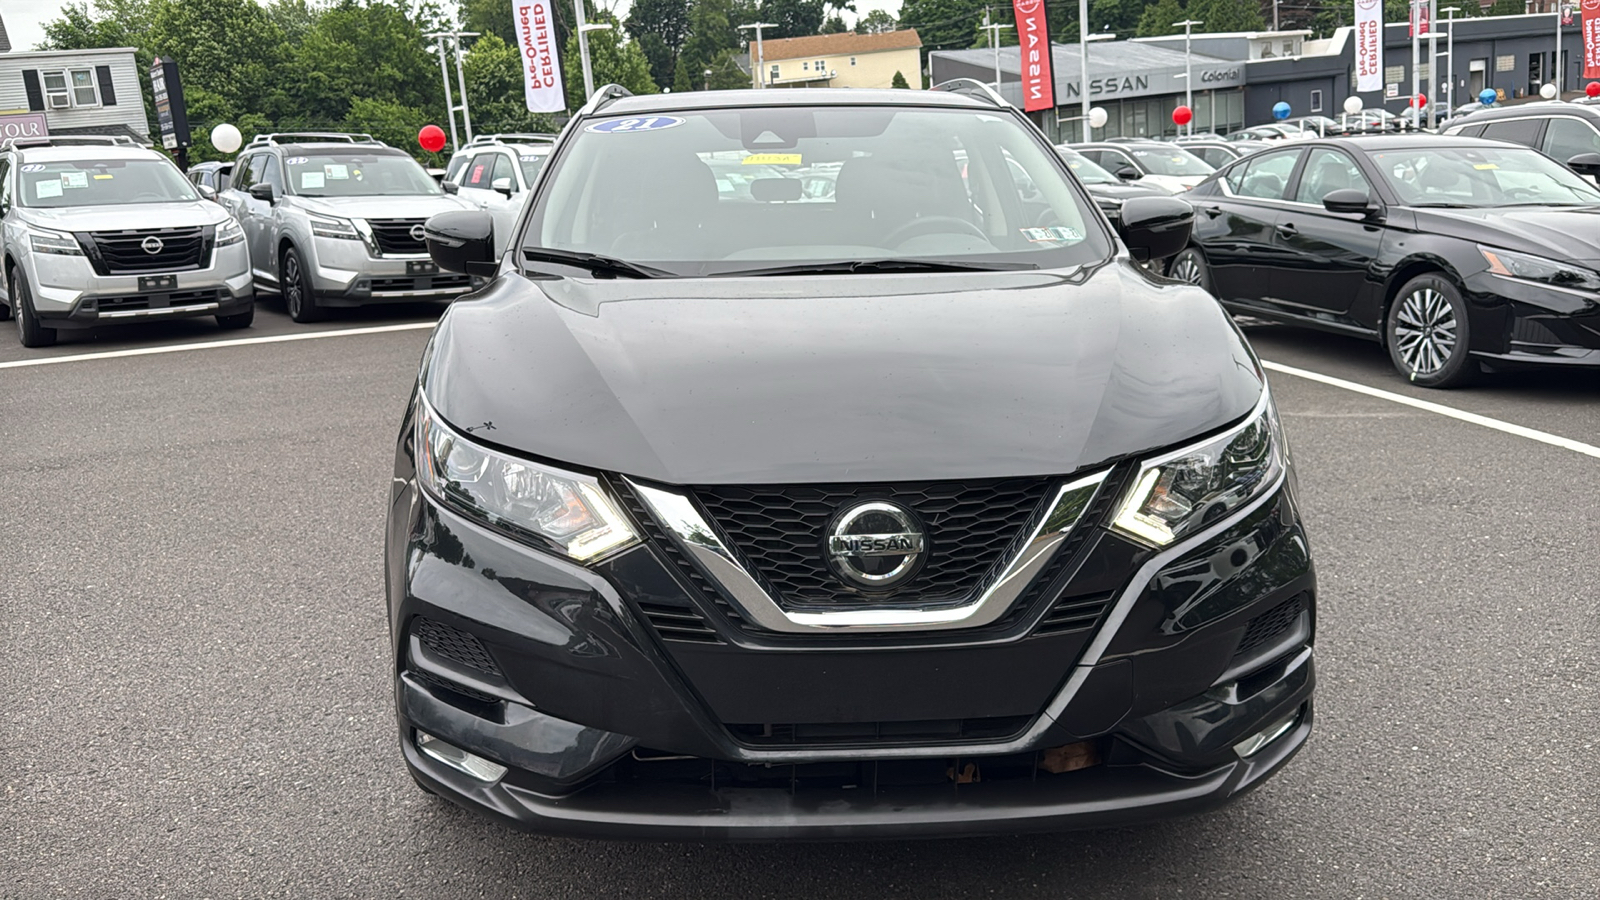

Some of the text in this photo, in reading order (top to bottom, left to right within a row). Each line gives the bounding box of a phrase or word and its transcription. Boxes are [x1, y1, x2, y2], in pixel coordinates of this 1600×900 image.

[1200, 68, 1240, 84] Colonial
[1066, 74, 1149, 98] NSSAN
[611, 117, 659, 131] 21
[840, 537, 913, 551] NISSAN
